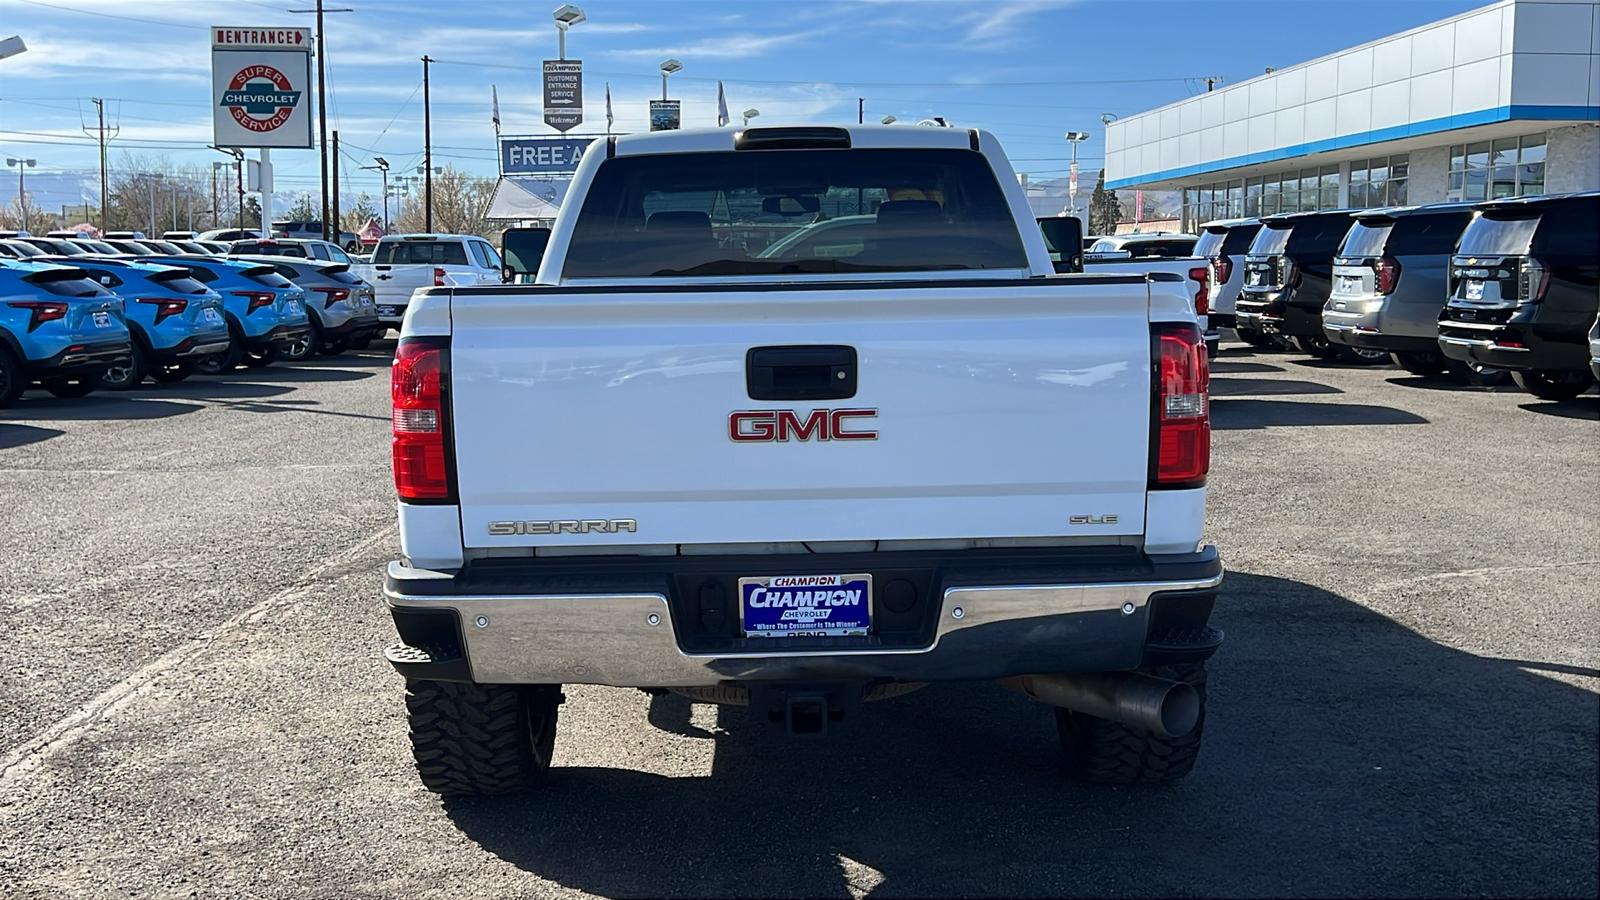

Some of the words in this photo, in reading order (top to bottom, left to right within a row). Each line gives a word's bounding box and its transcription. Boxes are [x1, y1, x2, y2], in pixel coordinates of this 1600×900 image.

[226, 30, 293, 44] ENTRANCE
[236, 66, 282, 84] SUPER
[225, 94, 295, 103] CHEVROLET
[234, 109, 288, 131] SERVICE
[549, 116, 578, 124] Welcome!
[509, 146, 564, 166] FREE
[728, 407, 879, 443] GMC
[488, 519, 637, 535] SIERRA
[1069, 514, 1118, 525] SLE
[774, 576, 836, 587] CHAMPION
[749, 587, 862, 608] CHAMPION
[788, 622, 817, 630] Customer
